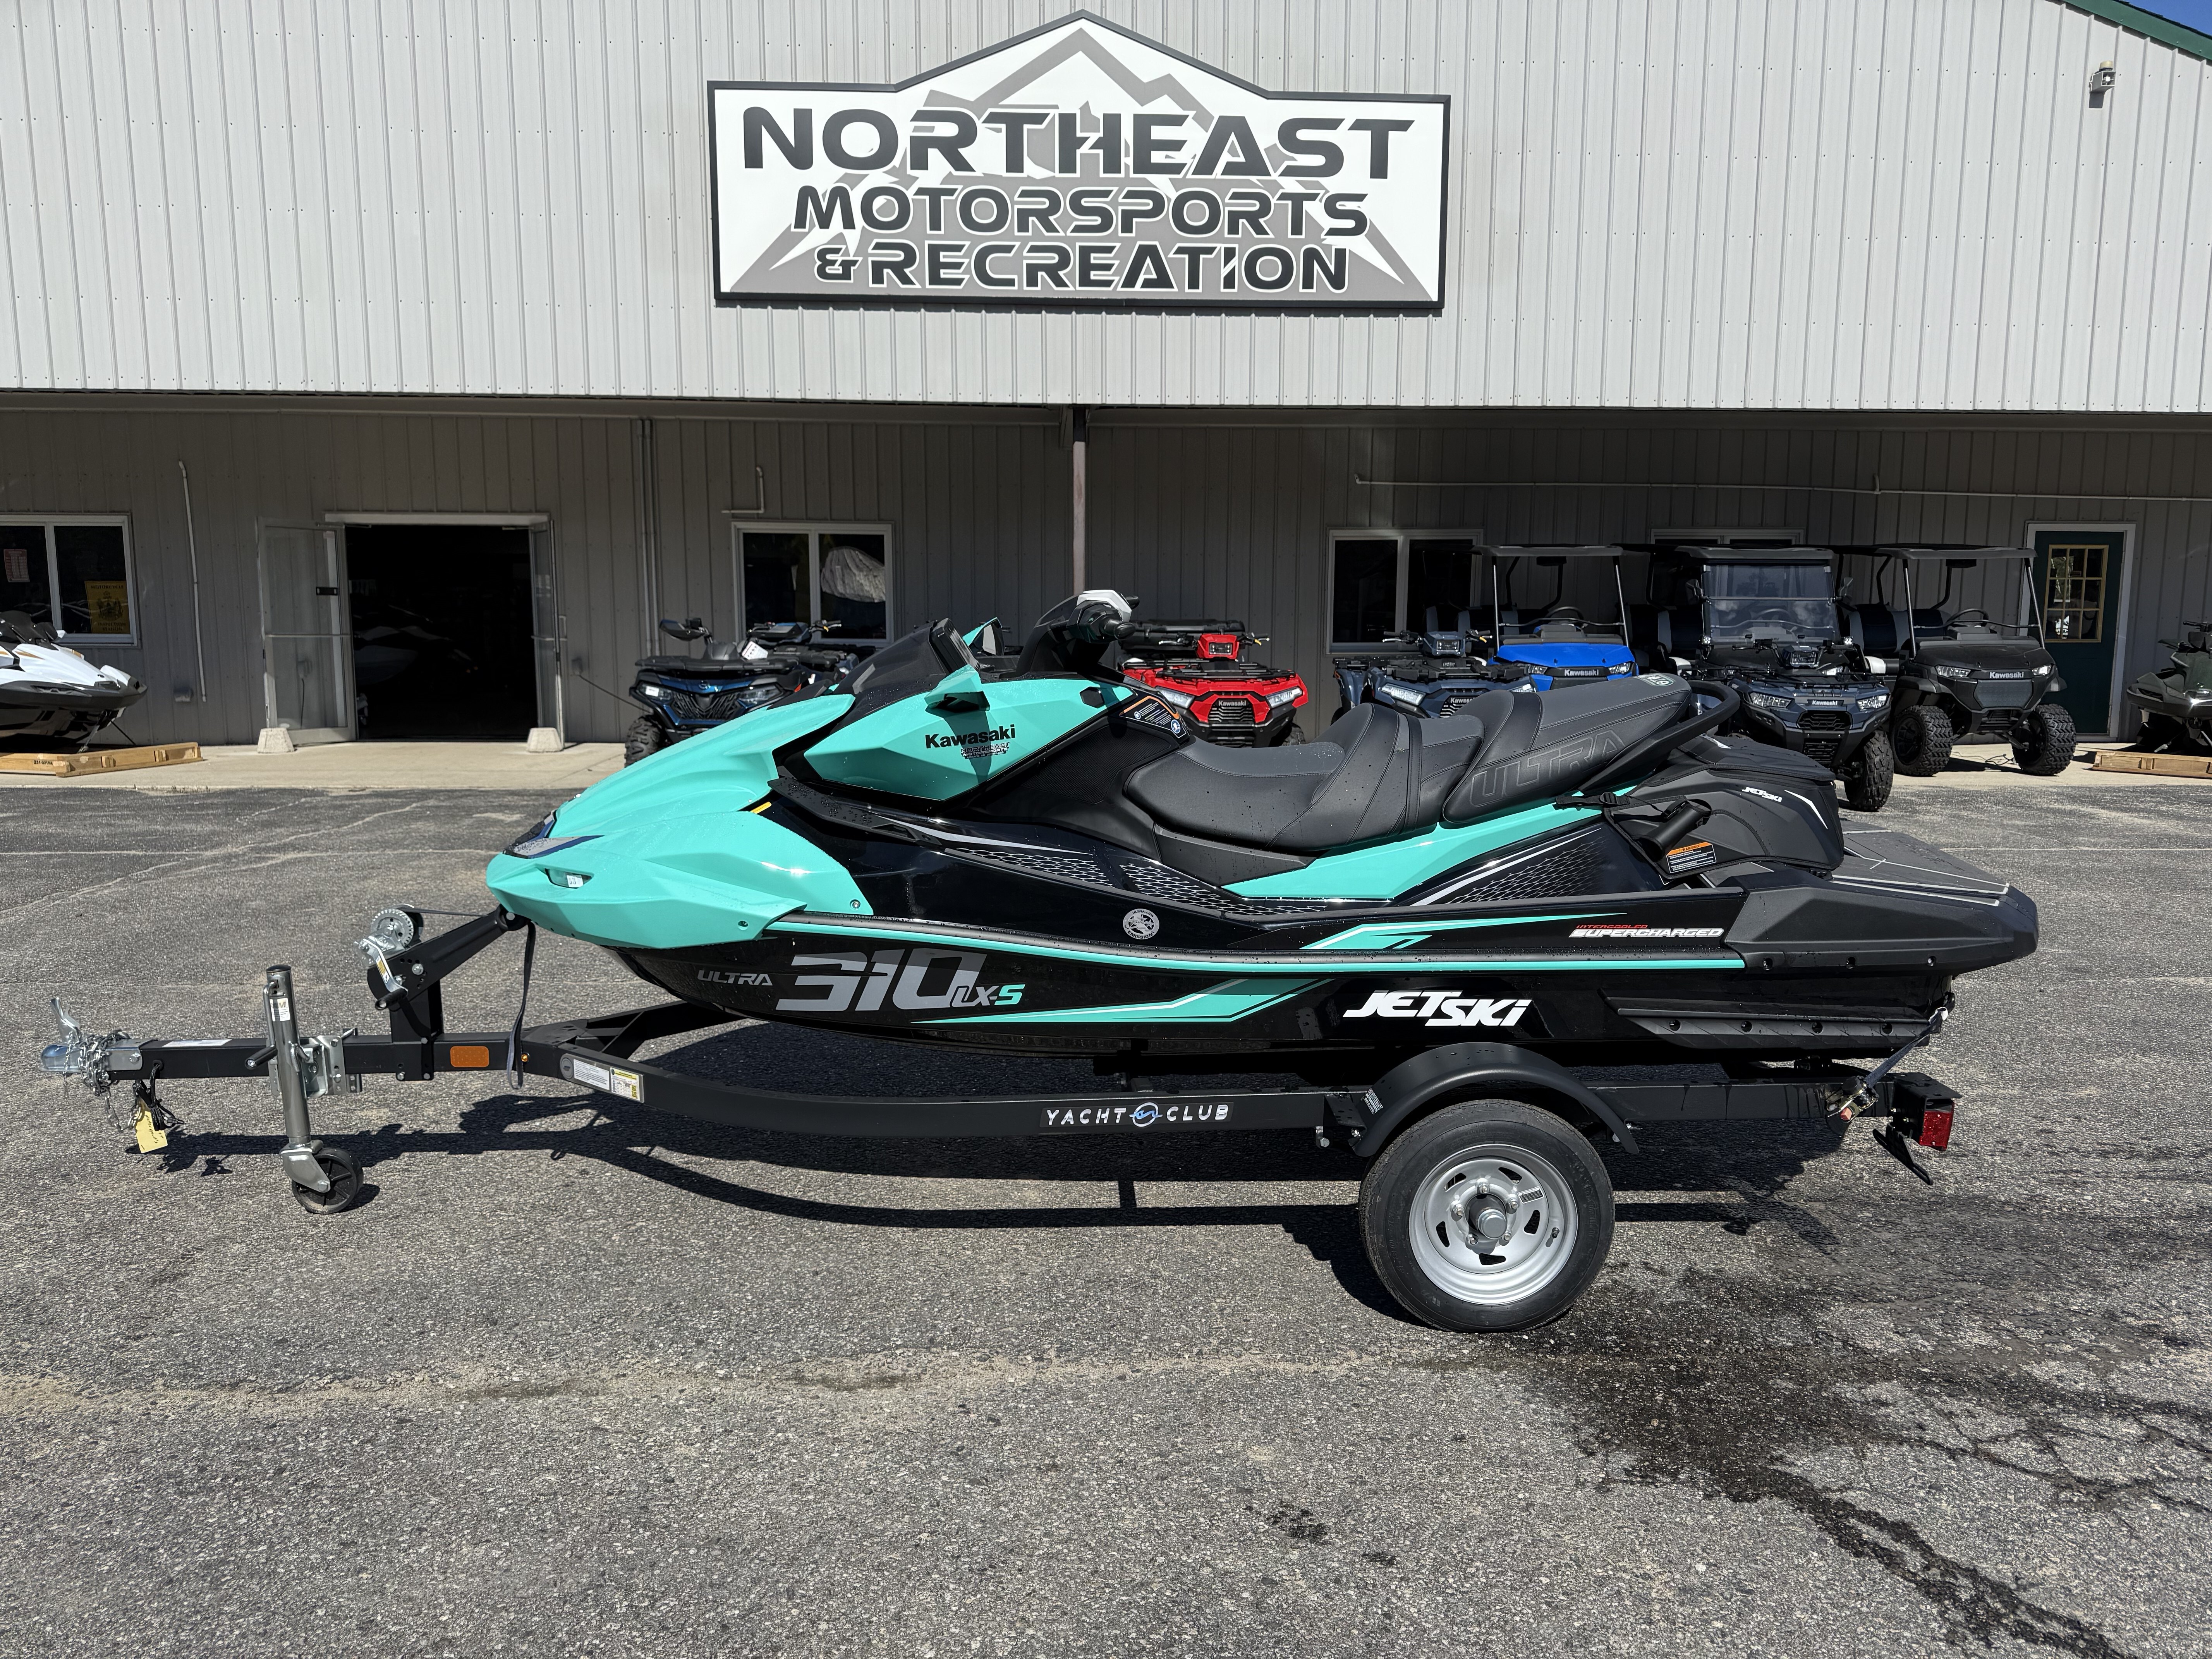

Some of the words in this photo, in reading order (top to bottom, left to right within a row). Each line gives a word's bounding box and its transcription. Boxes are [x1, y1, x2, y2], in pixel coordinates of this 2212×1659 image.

[743, 106, 1415, 180] NORTHEAST
[794, 185, 1369, 237] MOTORSPORTS
[925, 724, 1016, 749] Kawasaki
[961, 742, 1010, 753] NORTHEAST
[963, 747, 1008, 757] MOTORSPORTS
[1570, 928, 1724, 938] SUPERCHARGED
[697, 970, 773, 986] ULTRA
[776, 948, 988, 1011] 310
[1047, 1108, 1127, 1125] YACHT
[1166, 1104, 1229, 1121] CLUB
